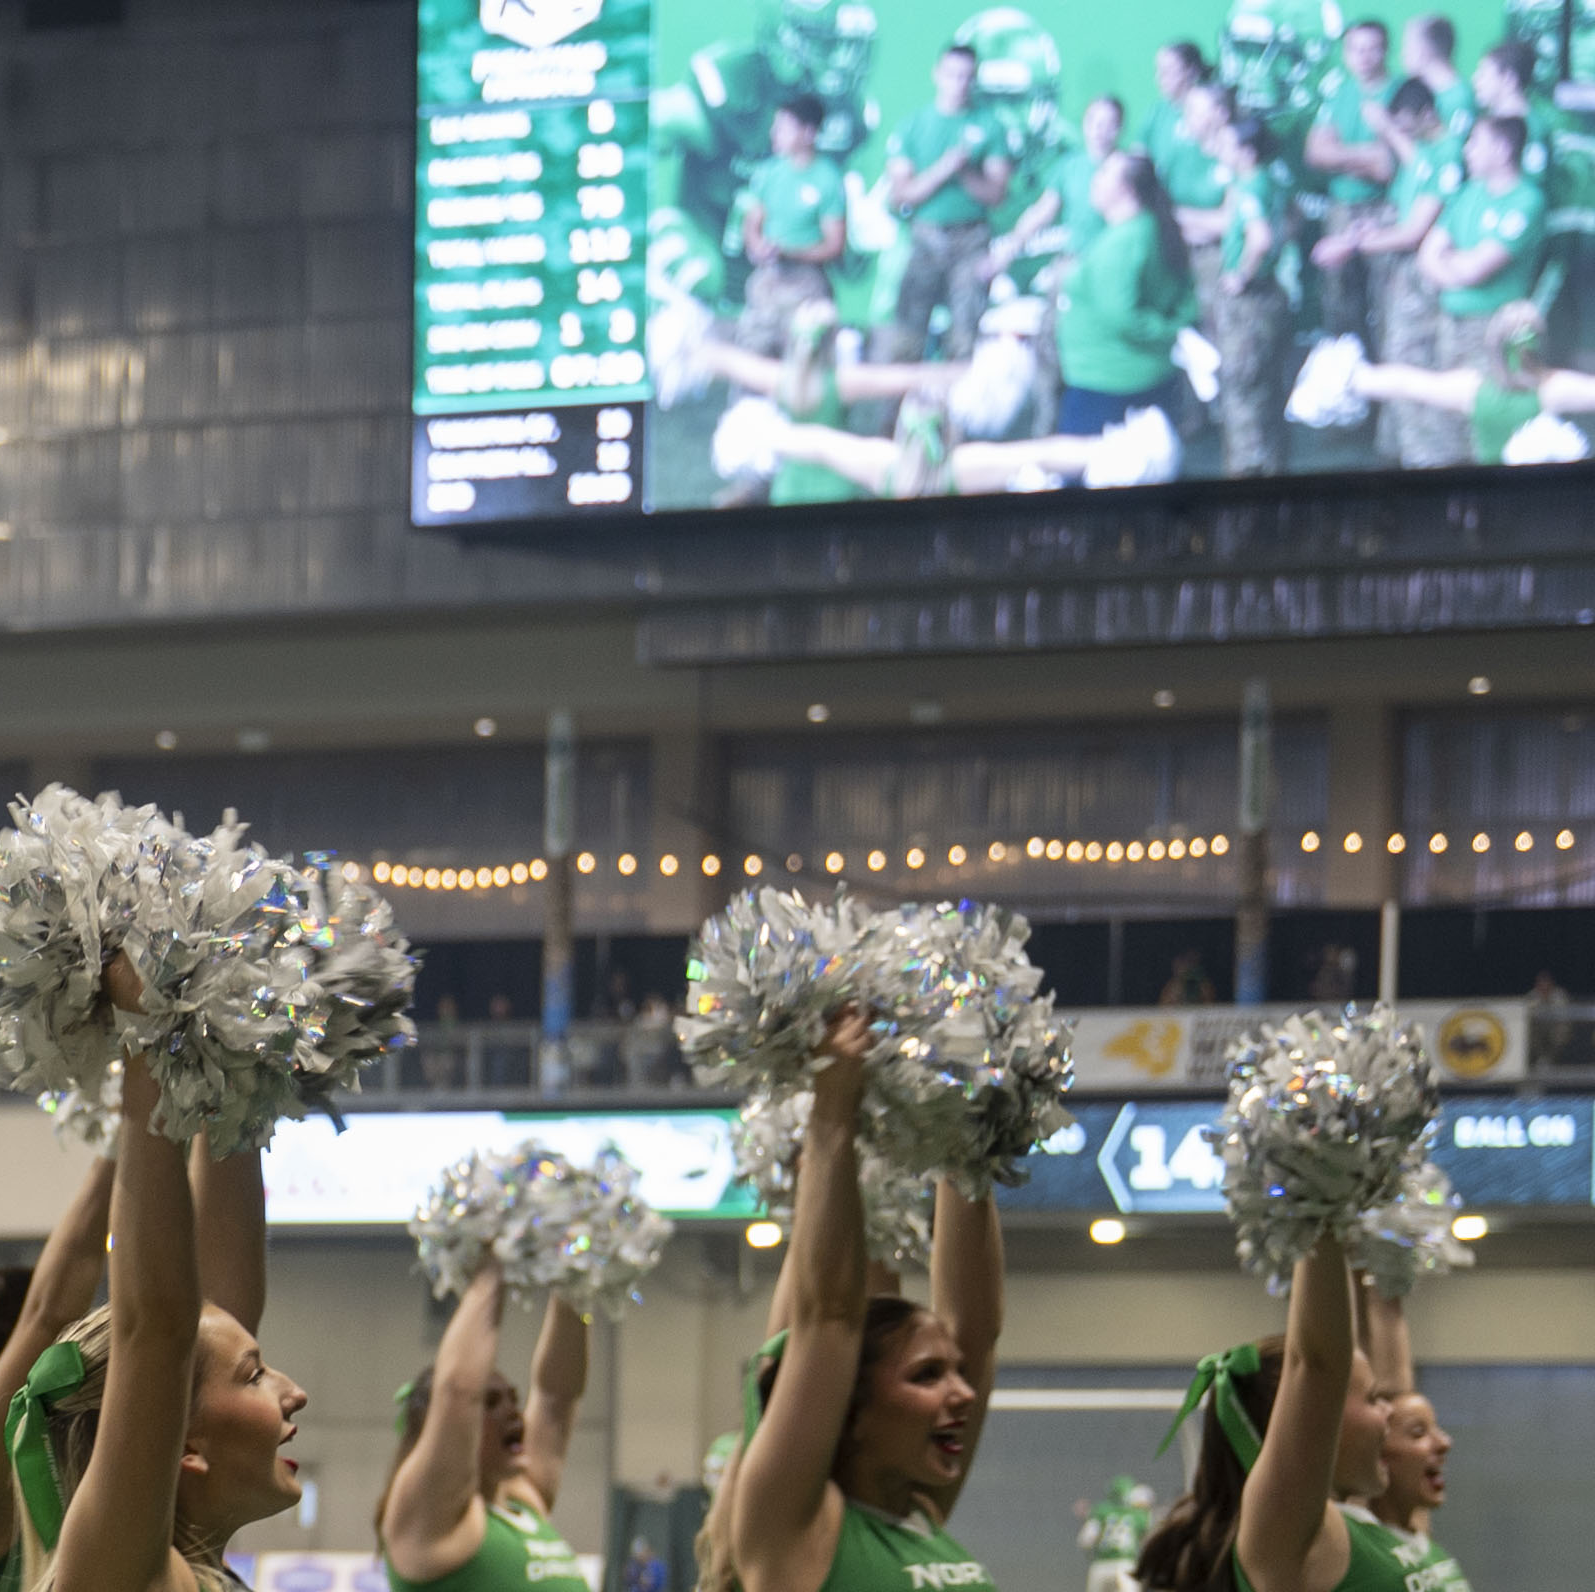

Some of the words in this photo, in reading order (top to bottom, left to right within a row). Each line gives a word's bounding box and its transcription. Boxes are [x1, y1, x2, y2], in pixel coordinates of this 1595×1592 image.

[1454, 1115, 1528, 1148] BALL
[1528, 1114, 1575, 1147] ON
[902, 1561, 989, 1590] NOR
